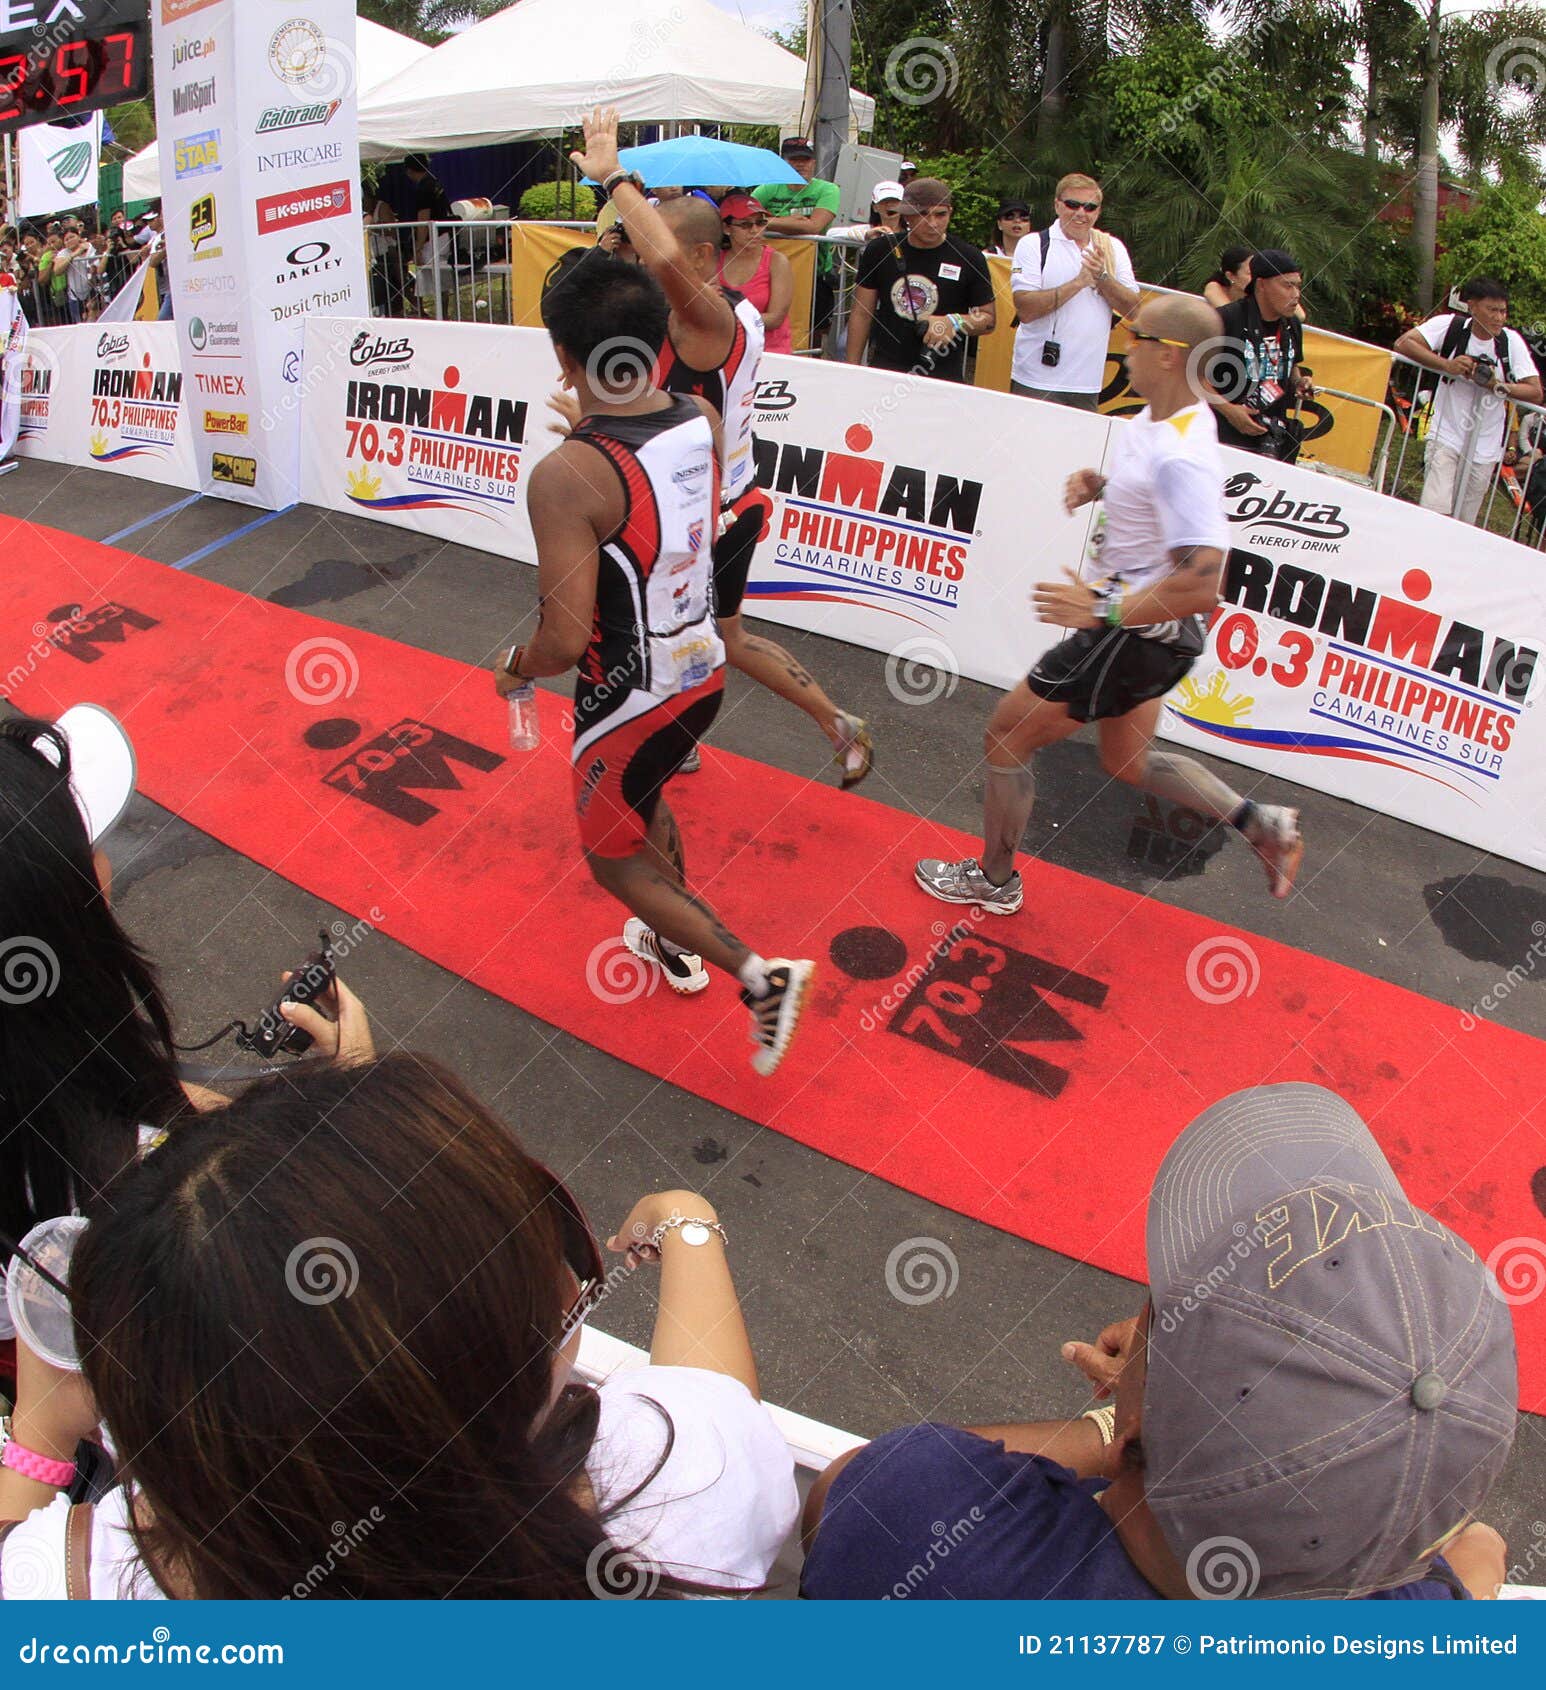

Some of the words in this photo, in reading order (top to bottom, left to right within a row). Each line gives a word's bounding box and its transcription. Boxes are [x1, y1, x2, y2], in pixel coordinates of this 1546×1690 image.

[172, 37, 216, 71] juice.ph
[260, 103, 328, 129] Gatorade
[175, 139, 220, 173] STAR
[257, 142, 343, 172] INTERCARE
[276, 257, 344, 284] OAKLEY
[271, 300, 311, 322] Dusit
[312, 284, 352, 308] Thani
[97, 331, 130, 359] Cobra
[350, 331, 414, 367] Cobra
[93, 368, 182, 403] IRONMAN
[195, 374, 247, 396] TIMEX
[368, 367, 391, 378] ENERGY
[90, 398, 122, 429] 70.3
[122, 405, 178, 432] PHILIPPINES
[205, 411, 247, 433] PowerBar
[346, 379, 529, 445] IRONMAN
[757, 413, 790, 423] DRINK
[345, 420, 405, 467] 70.3
[408, 437, 519, 483] PHILIPPINES
[407, 464, 482, 492] CAMARINES
[487, 481, 516, 498] SUR
[780, 507, 967, 582] PHILIPPINES
[1249, 534, 1299, 549] ENERGY
[1300, 538, 1342, 554] DRINK
[776, 544, 902, 586] CAMARINES
[914, 576, 959, 601] SUR
[1318, 652, 1516, 752] PHILIPPINES
[1313, 691, 1449, 751] CAMARINES
[1459, 743, 1503, 772] SUR
[326, 723, 434, 790] 70.3
[902, 937, 1007, 1048] 70.3
